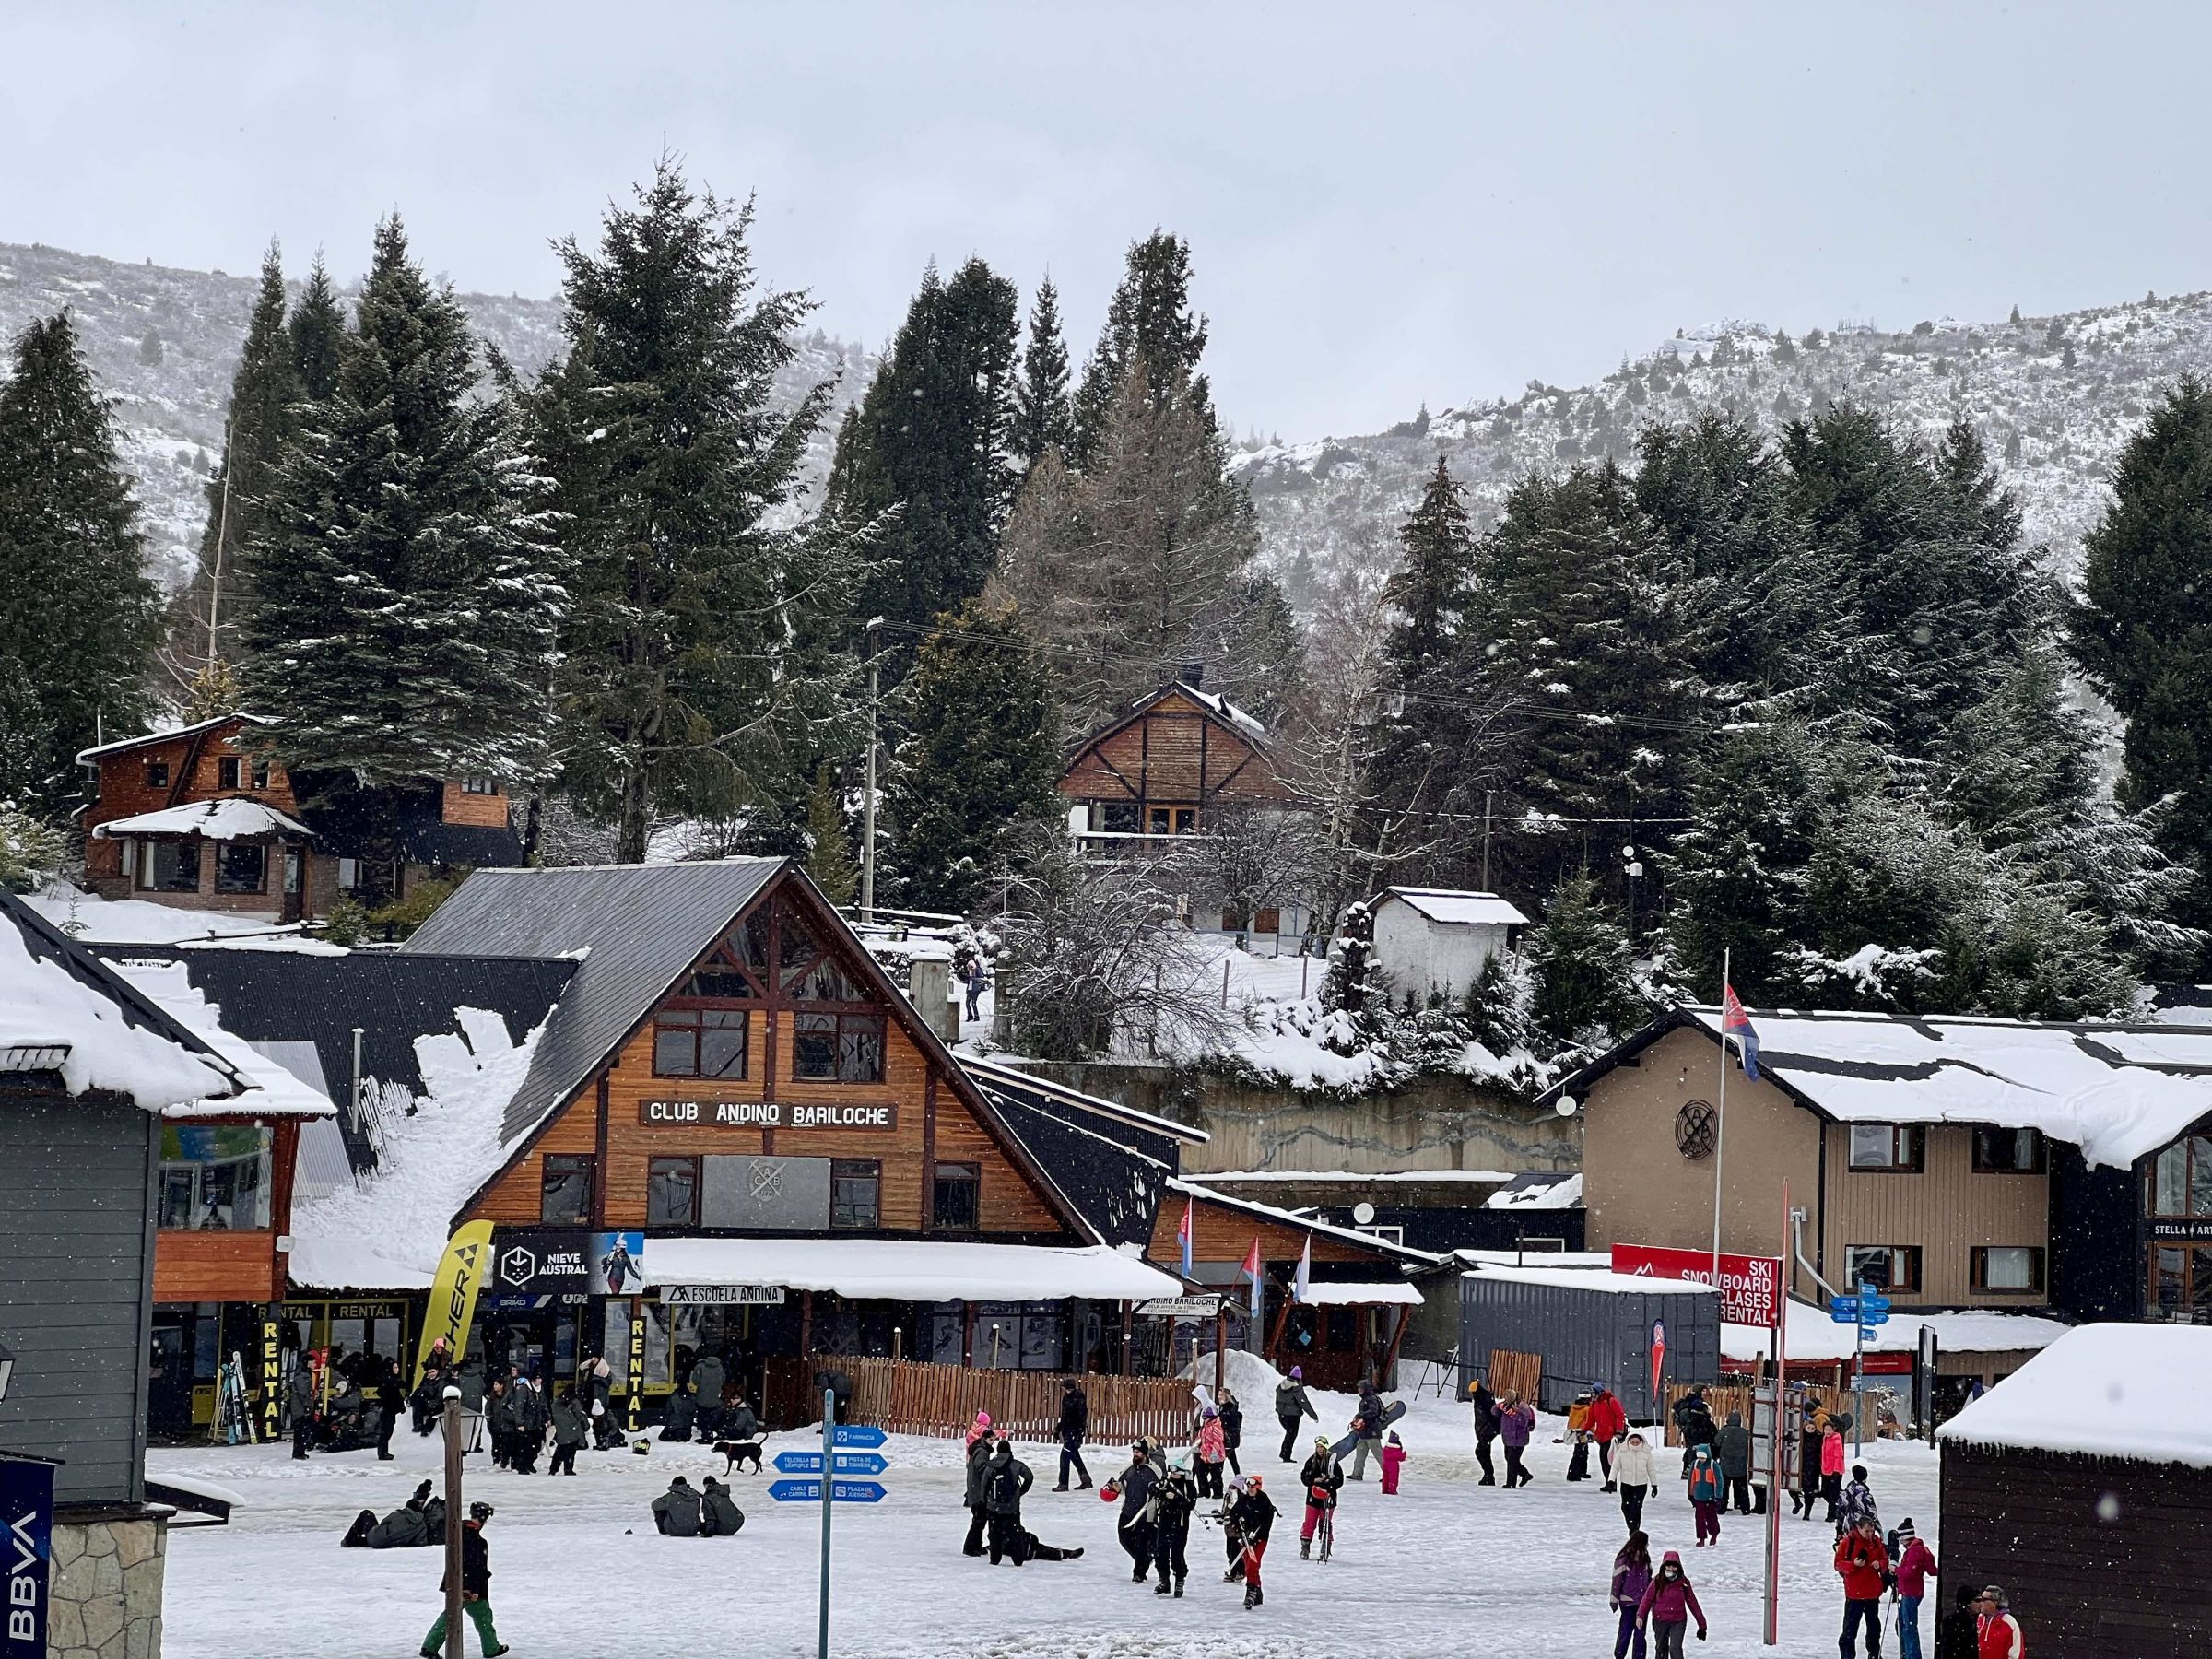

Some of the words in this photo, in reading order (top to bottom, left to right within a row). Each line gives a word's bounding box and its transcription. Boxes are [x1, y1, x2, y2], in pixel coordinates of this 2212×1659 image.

[650, 1102, 699, 1120] CLUB
[716, 1104, 780, 1122] ANDINO
[794, 1106, 889, 1124] BARILOCHE
[2155, 1225, 2187, 1235] STELLA
[547, 1253, 581, 1265] NIEVE
[538, 1263, 589, 1276] AUSTRAL
[1748, 1260, 1772, 1277] SKI
[692, 1287, 737, 1302] ESCUELA
[740, 1287, 779, 1302] ANDINA
[1174, 1298, 1217, 1306] BARILOCHE
[259, 1306, 314, 1319] RNTAL
[339, 1304, 394, 1318] RENTAL
[264, 1322, 278, 1438] RENTAL
[628, 1320, 644, 1430] RENTAL
[9, 1511, 37, 1641] BBVA
